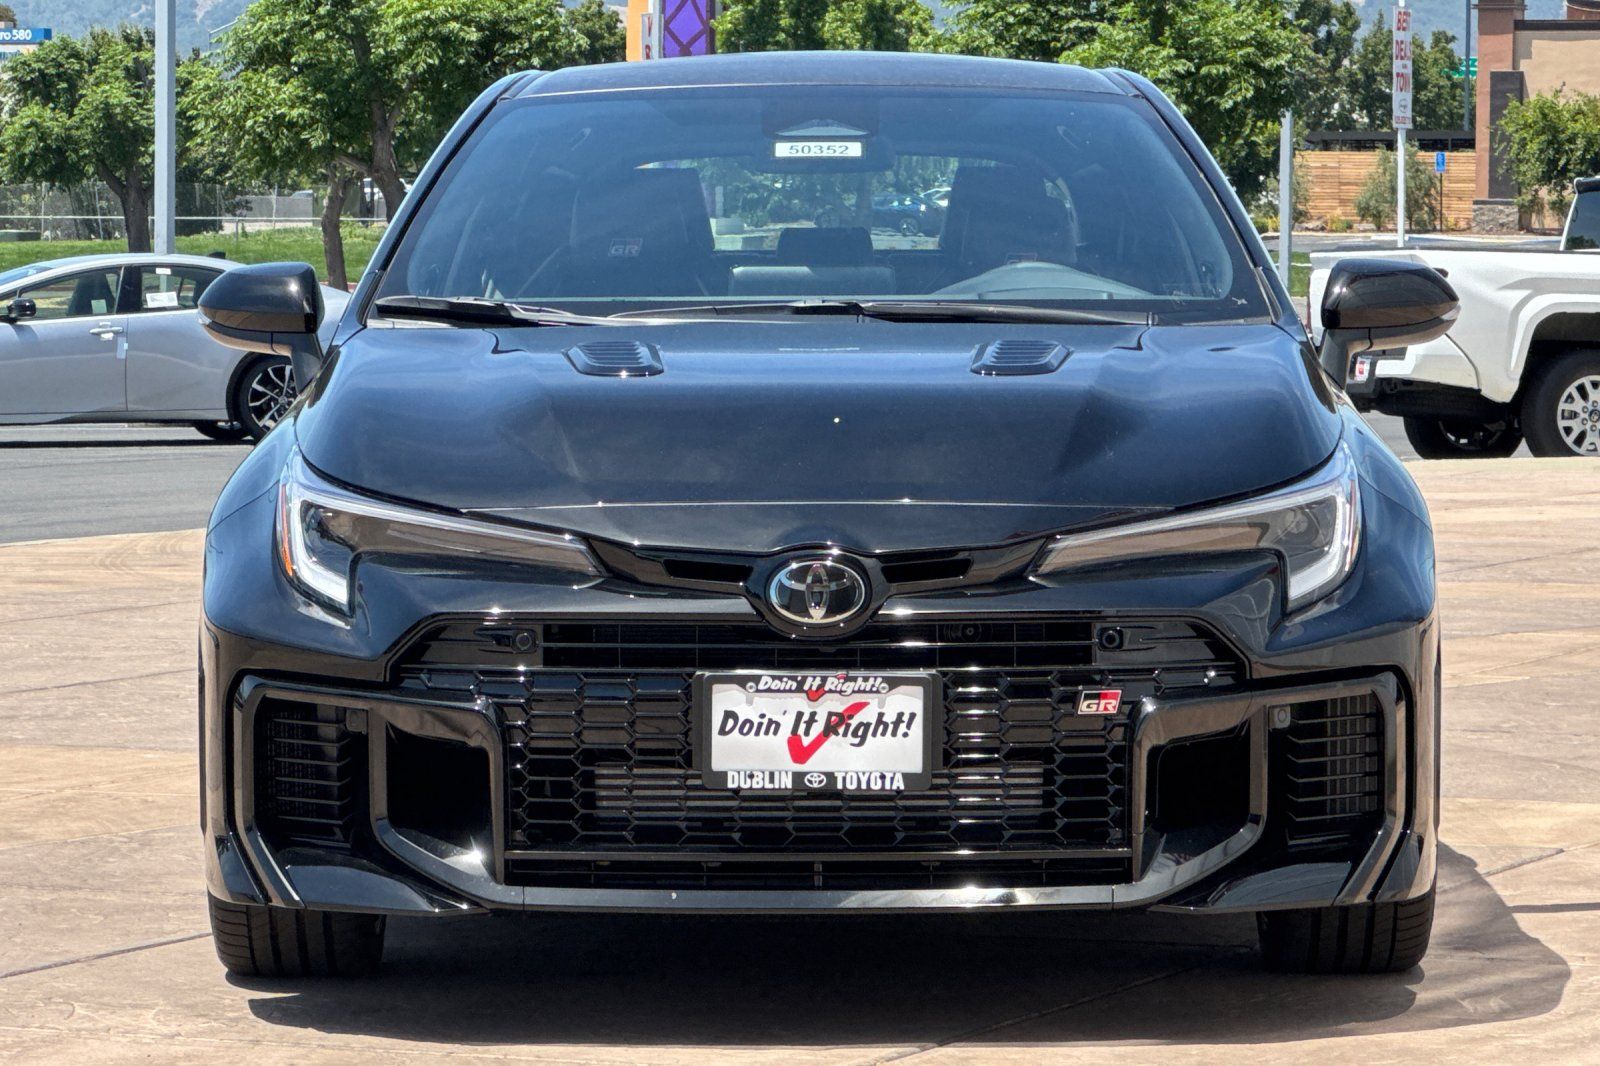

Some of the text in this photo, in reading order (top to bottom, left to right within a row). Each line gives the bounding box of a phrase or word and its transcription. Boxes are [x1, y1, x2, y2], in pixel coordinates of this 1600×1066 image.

[12, 29, 33, 41] 580
[788, 144, 849, 155] 50352
[610, 243, 640, 256] GR
[757, 676, 882, 697] Doin' It Right!
[1080, 697, 1117, 713] GR
[717, 709, 918, 748] Doin' It Right!
[727, 771, 906, 790] DUBLIN TOYOTA
